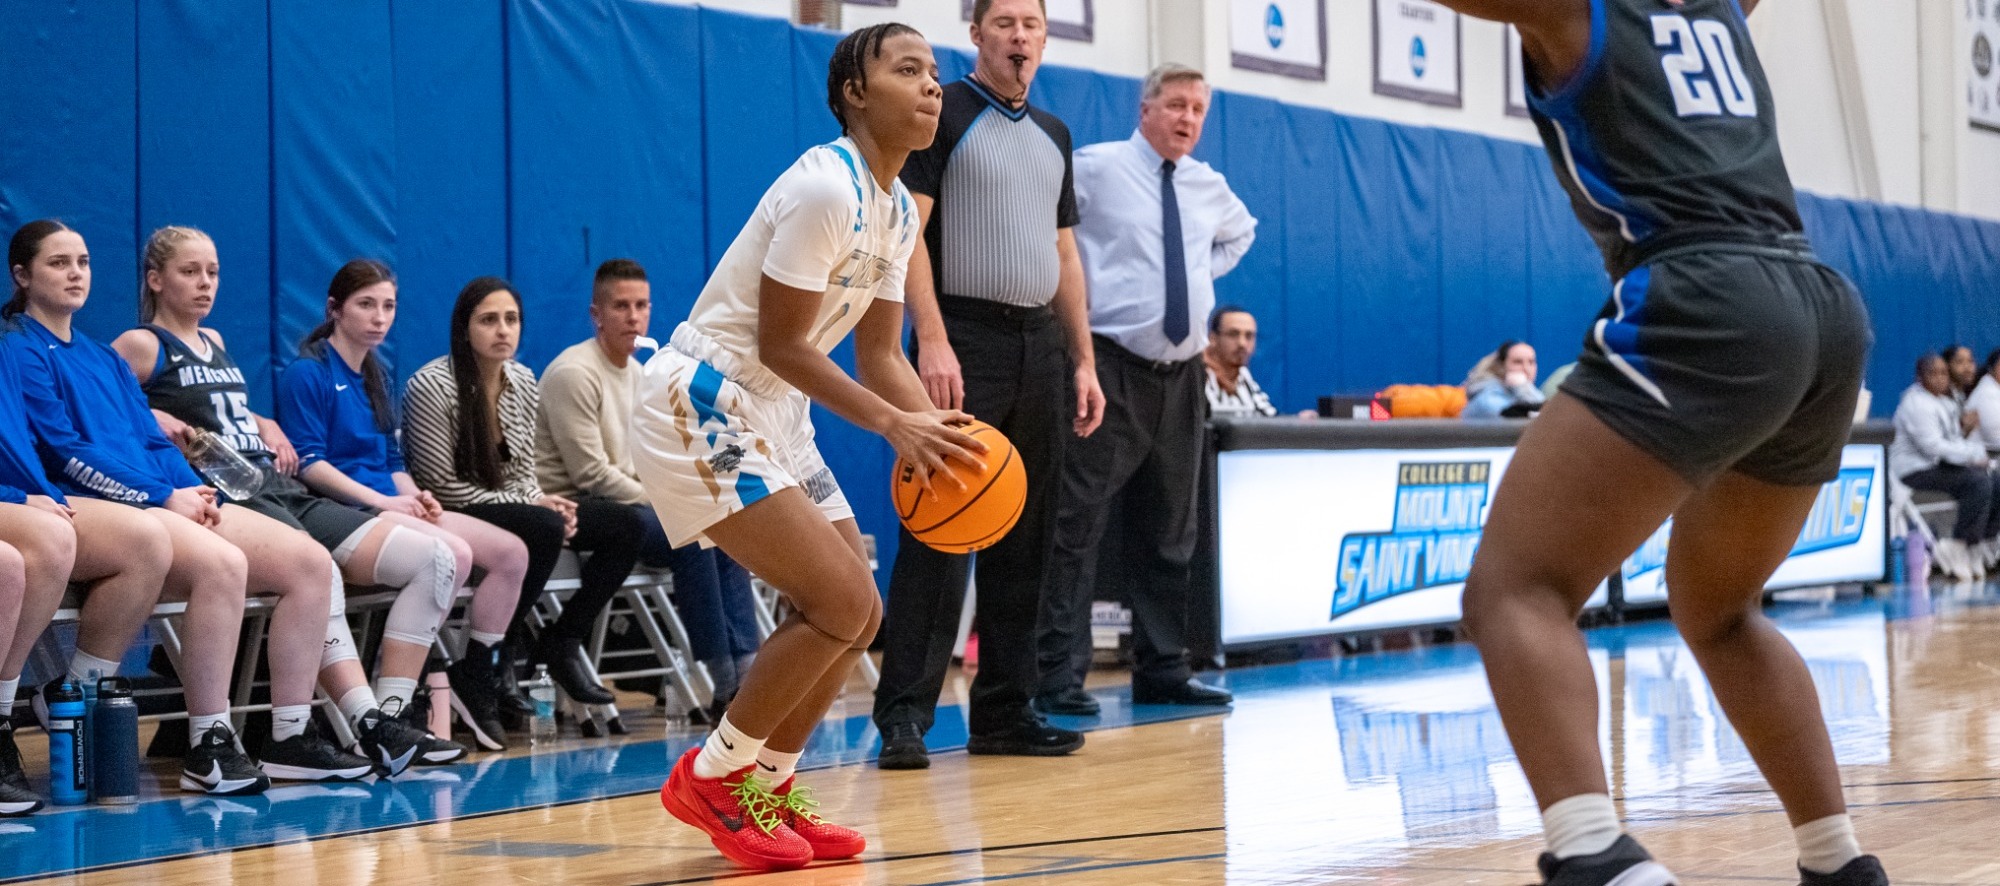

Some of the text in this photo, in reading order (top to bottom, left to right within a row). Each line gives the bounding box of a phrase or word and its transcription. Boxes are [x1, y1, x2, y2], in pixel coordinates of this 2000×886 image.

[1650, 14, 1758, 118] 20
[210, 391, 260, 435] 15
[1400, 463, 1489, 485] COLLEGE OF
[1397, 488, 1484, 528] MOUNT
[1336, 537, 1422, 605] SAINT
[76, 720, 85, 784] POWERADE
